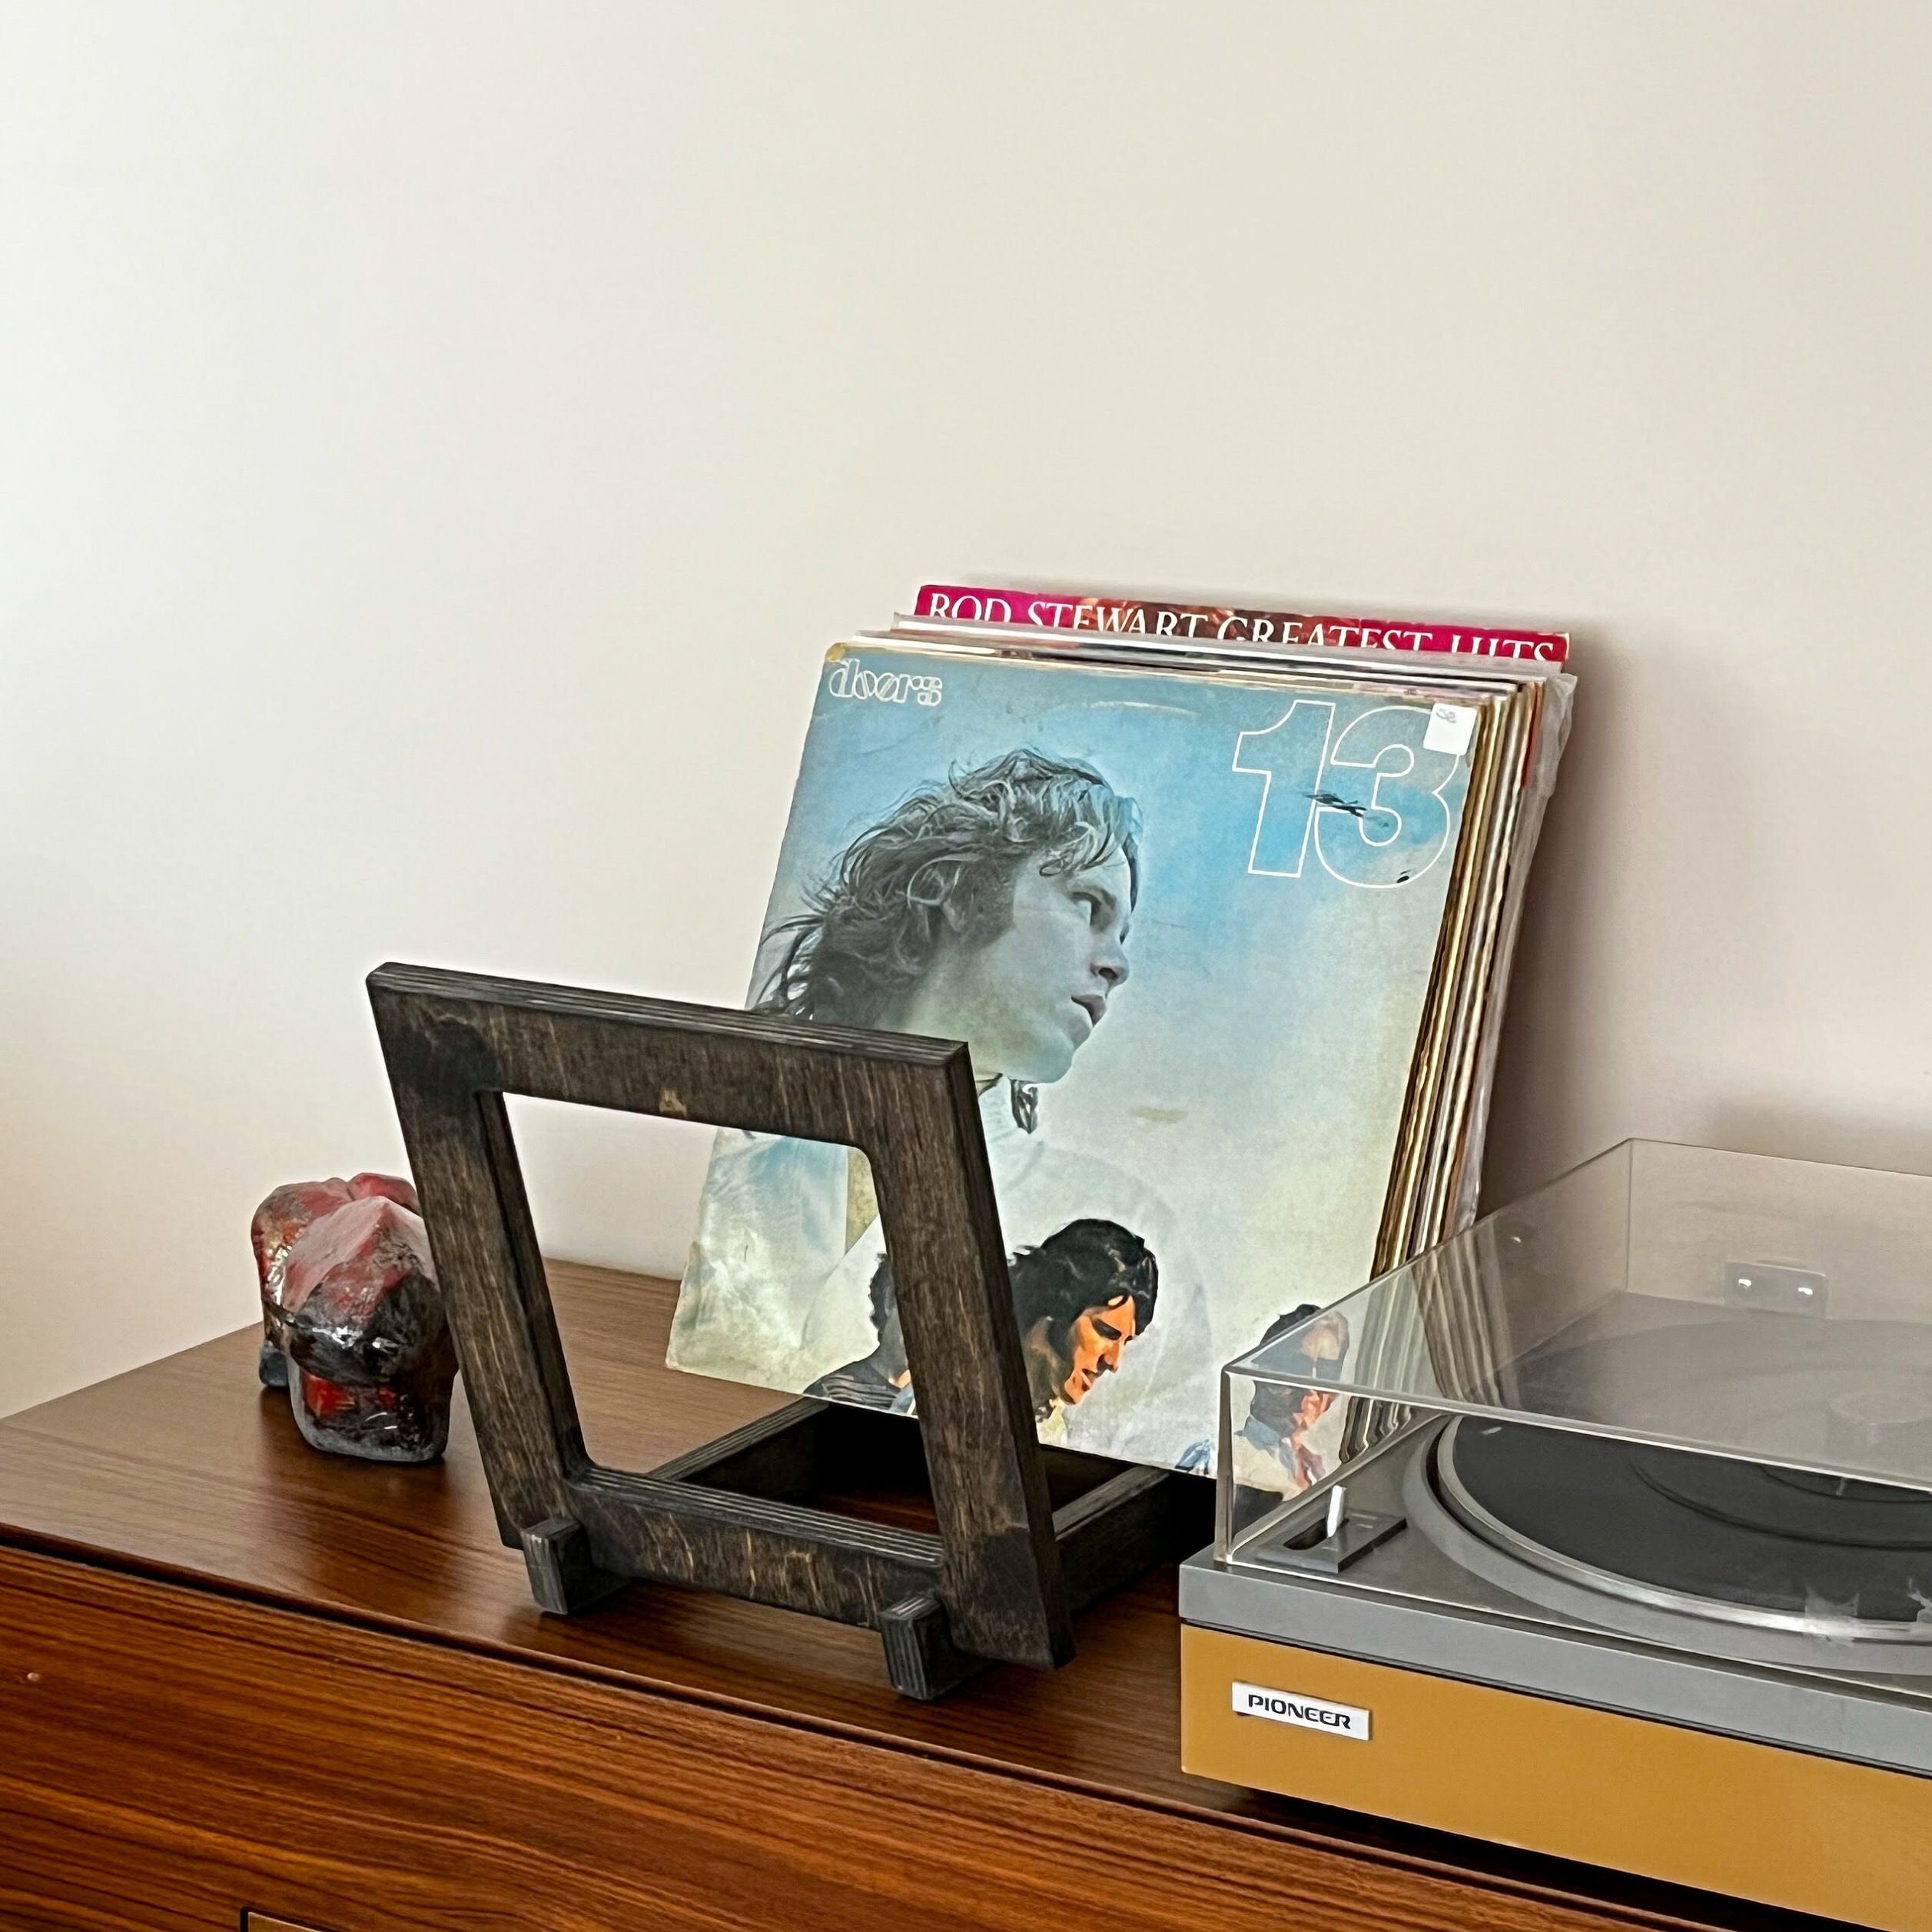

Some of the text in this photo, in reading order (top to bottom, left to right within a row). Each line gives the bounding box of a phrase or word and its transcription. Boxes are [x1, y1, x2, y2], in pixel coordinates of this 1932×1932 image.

[929, 593, 1012, 623] ROD
[1027, 601, 1208, 638] STEWART
[1217, 616, 1433, 652] GREATEST
[829, 658, 942, 705] doors
[1232, 699, 1459, 889] 13
[1248, 1694, 1351, 1729] PIONEER
